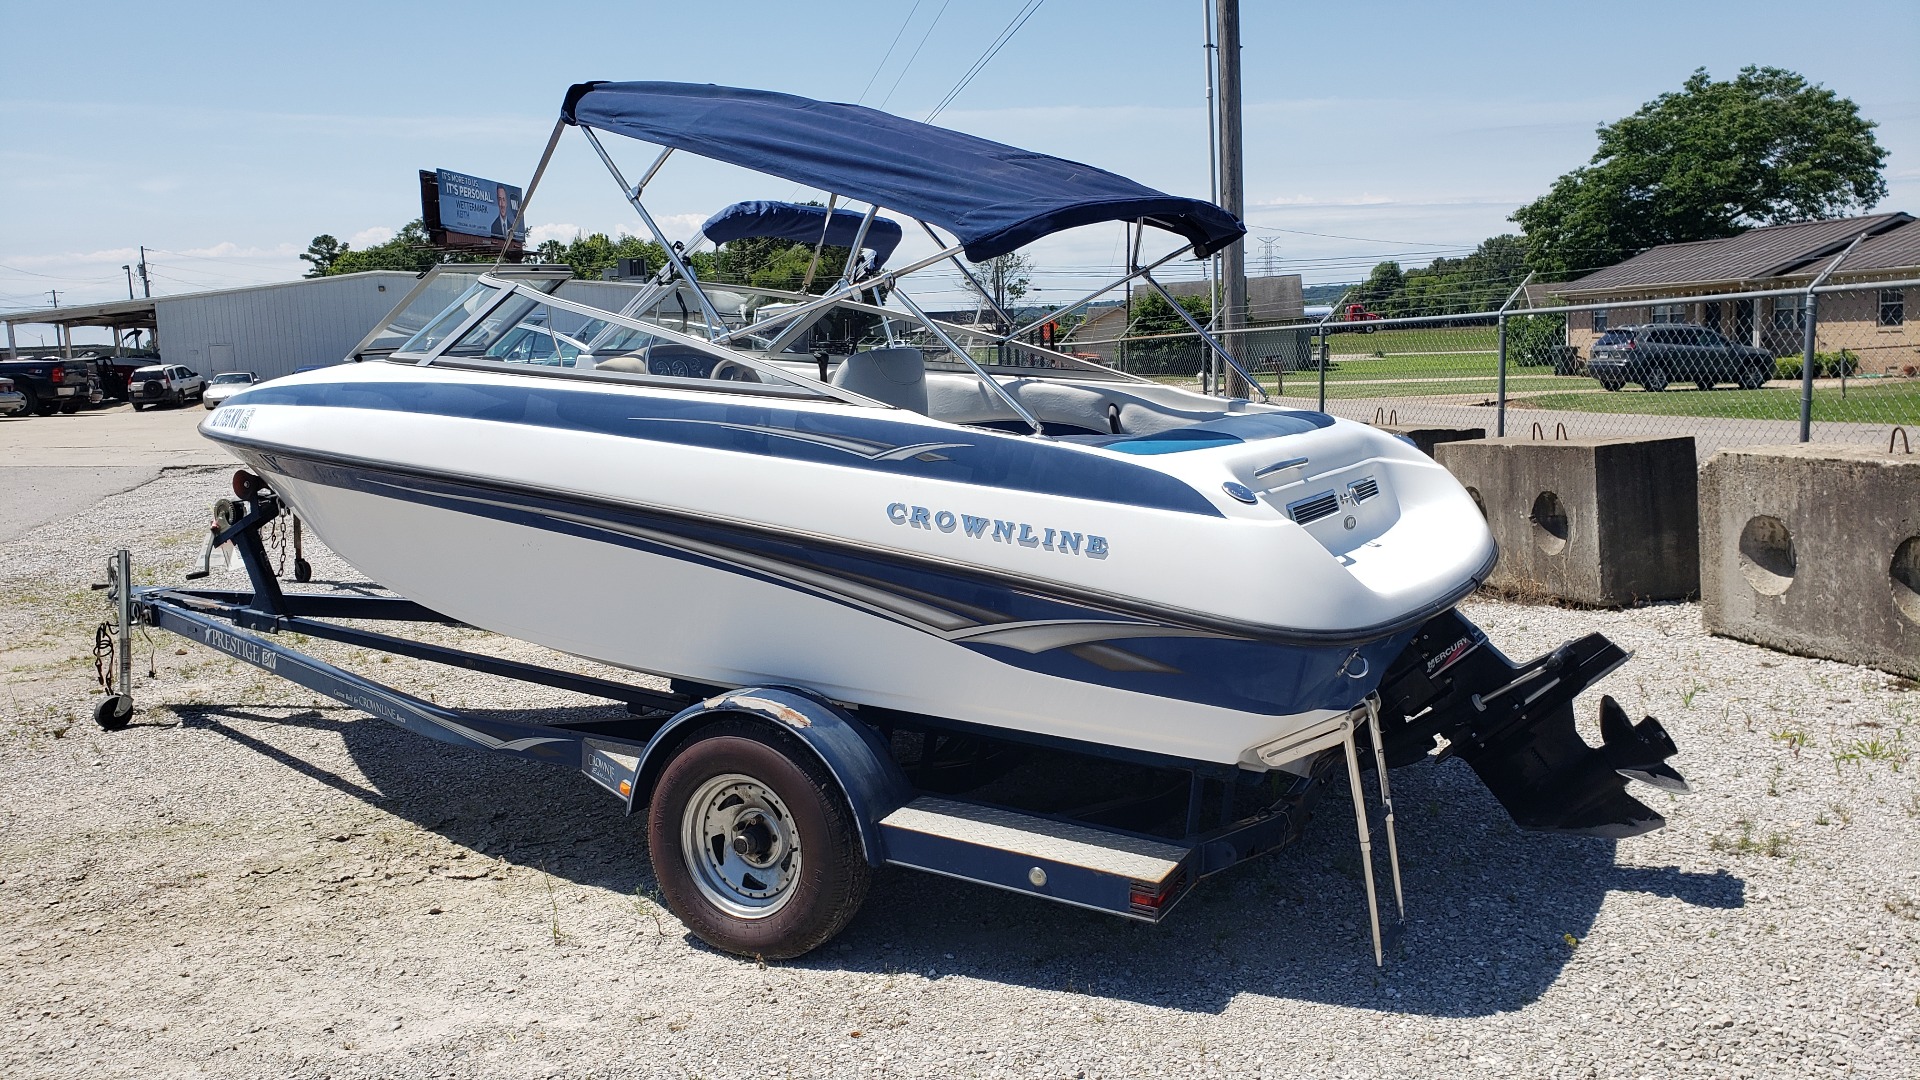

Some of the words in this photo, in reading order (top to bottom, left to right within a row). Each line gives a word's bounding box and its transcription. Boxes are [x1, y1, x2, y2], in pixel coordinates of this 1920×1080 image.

[446, 183, 459, 195] IT'S
[451, 174, 465, 184] MORE
[886, 502, 1110, 560] CROWNLINE
[211, 628, 260, 663] PRESTIGE
[1427, 637, 1468, 669] MERCURY
